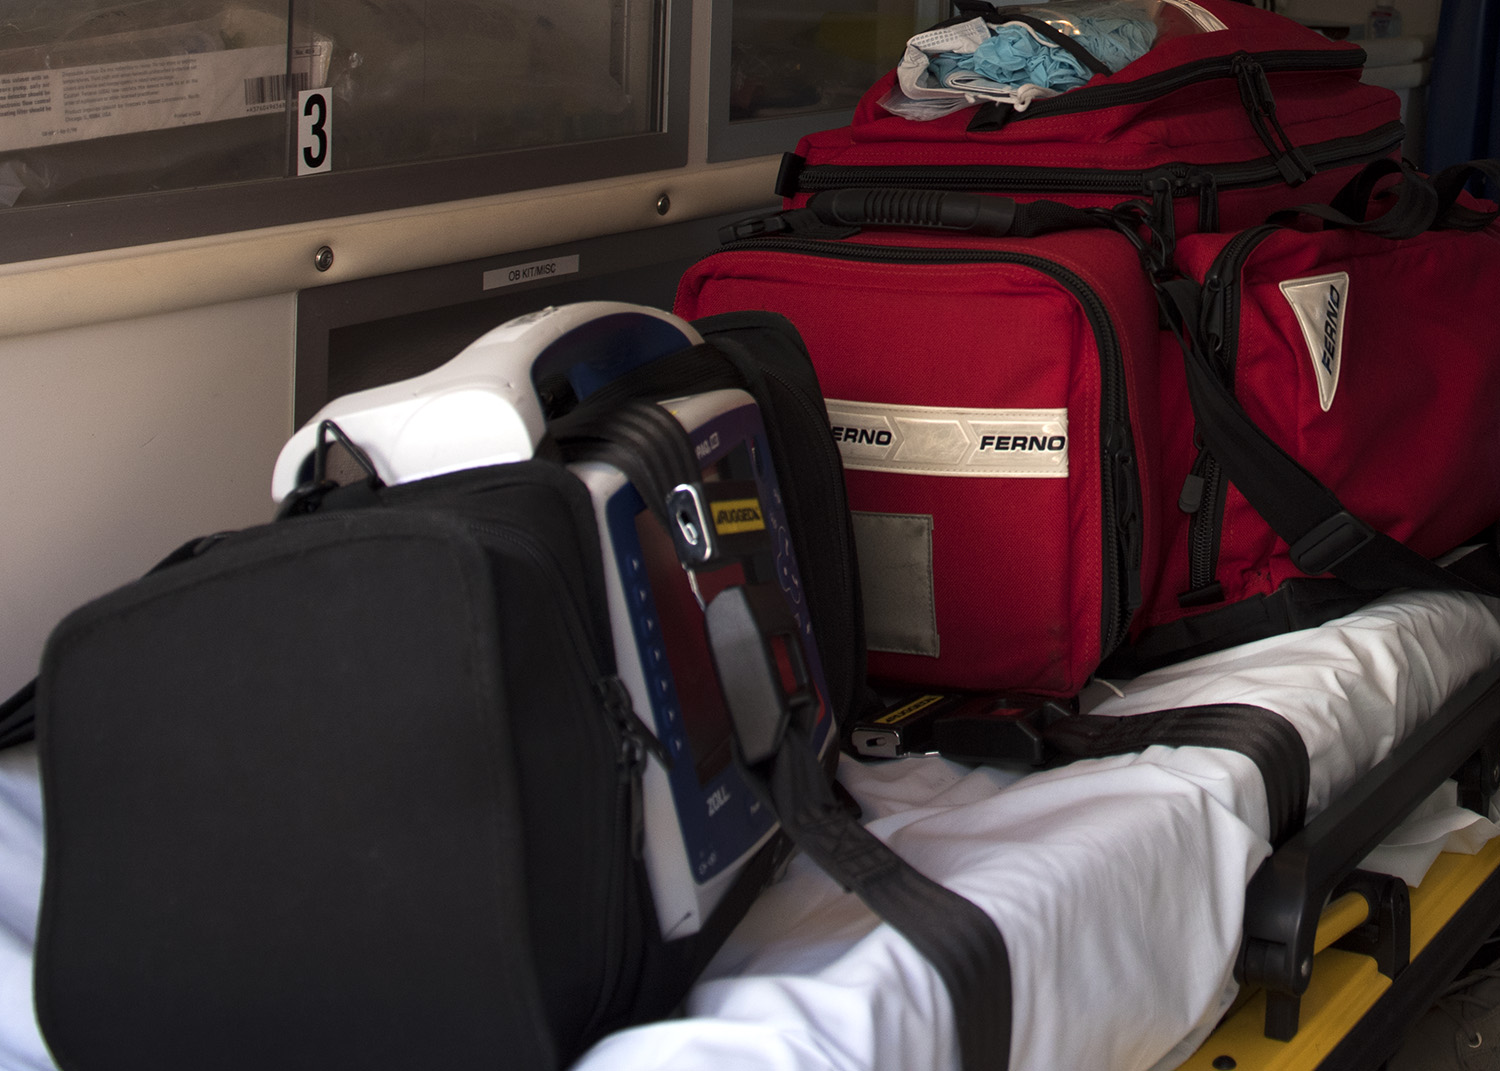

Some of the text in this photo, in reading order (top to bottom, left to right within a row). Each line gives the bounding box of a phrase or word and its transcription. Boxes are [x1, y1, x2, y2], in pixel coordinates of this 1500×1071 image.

[303, 93, 328, 168] 3
[508, 263, 557, 282] OB KIT/MISC
[1321, 284, 1340, 376] FERNO
[830, 426, 1066, 451] ERNO FERNO
